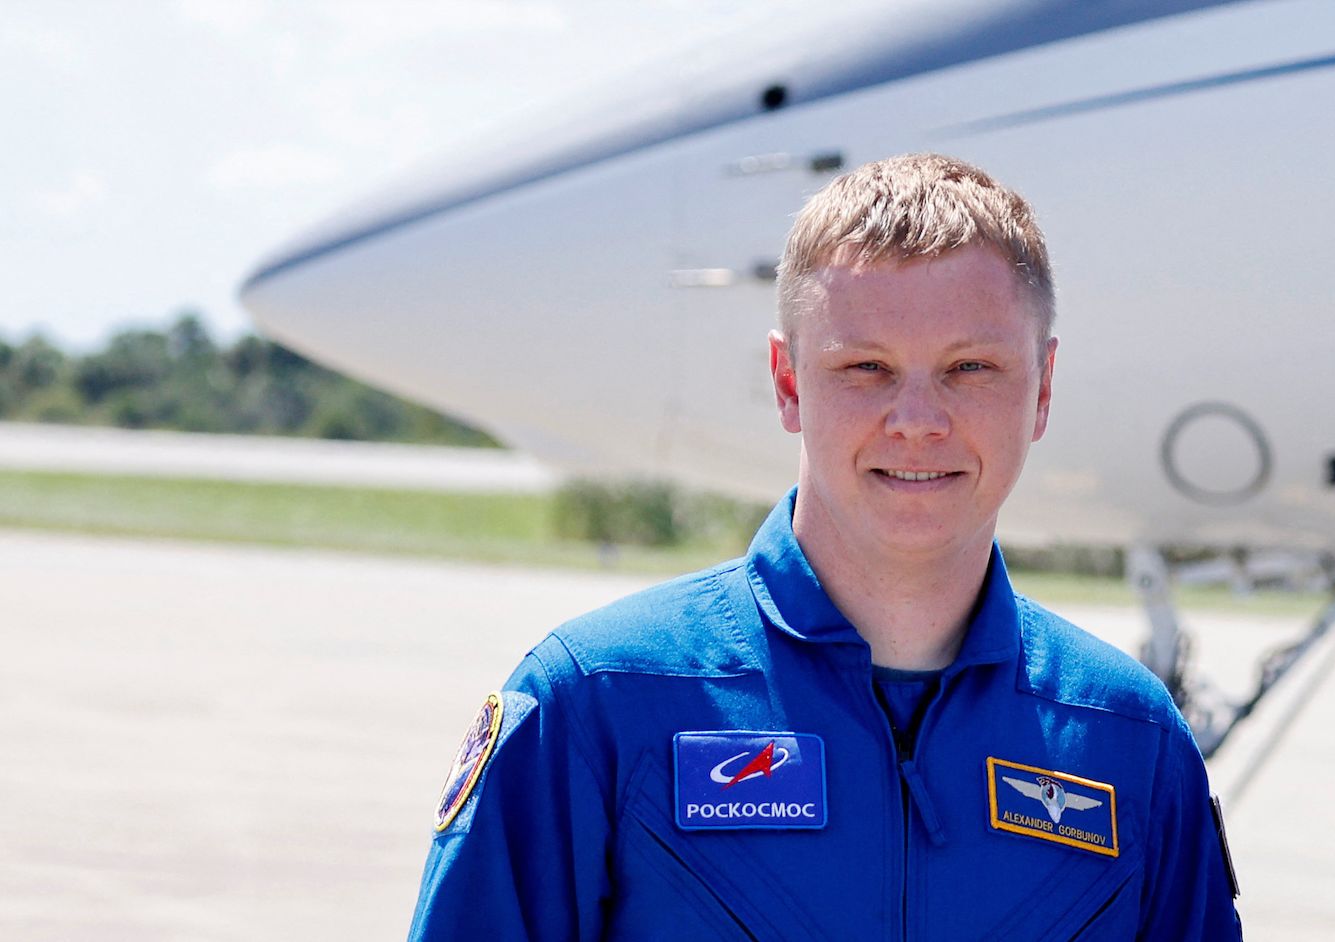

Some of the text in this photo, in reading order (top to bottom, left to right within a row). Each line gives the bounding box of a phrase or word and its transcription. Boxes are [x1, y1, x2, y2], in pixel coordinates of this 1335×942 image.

[687, 802, 815, 818] РОСКОСМОС
[1003, 810, 1106, 845] ALEXANDER GORBUNOV
